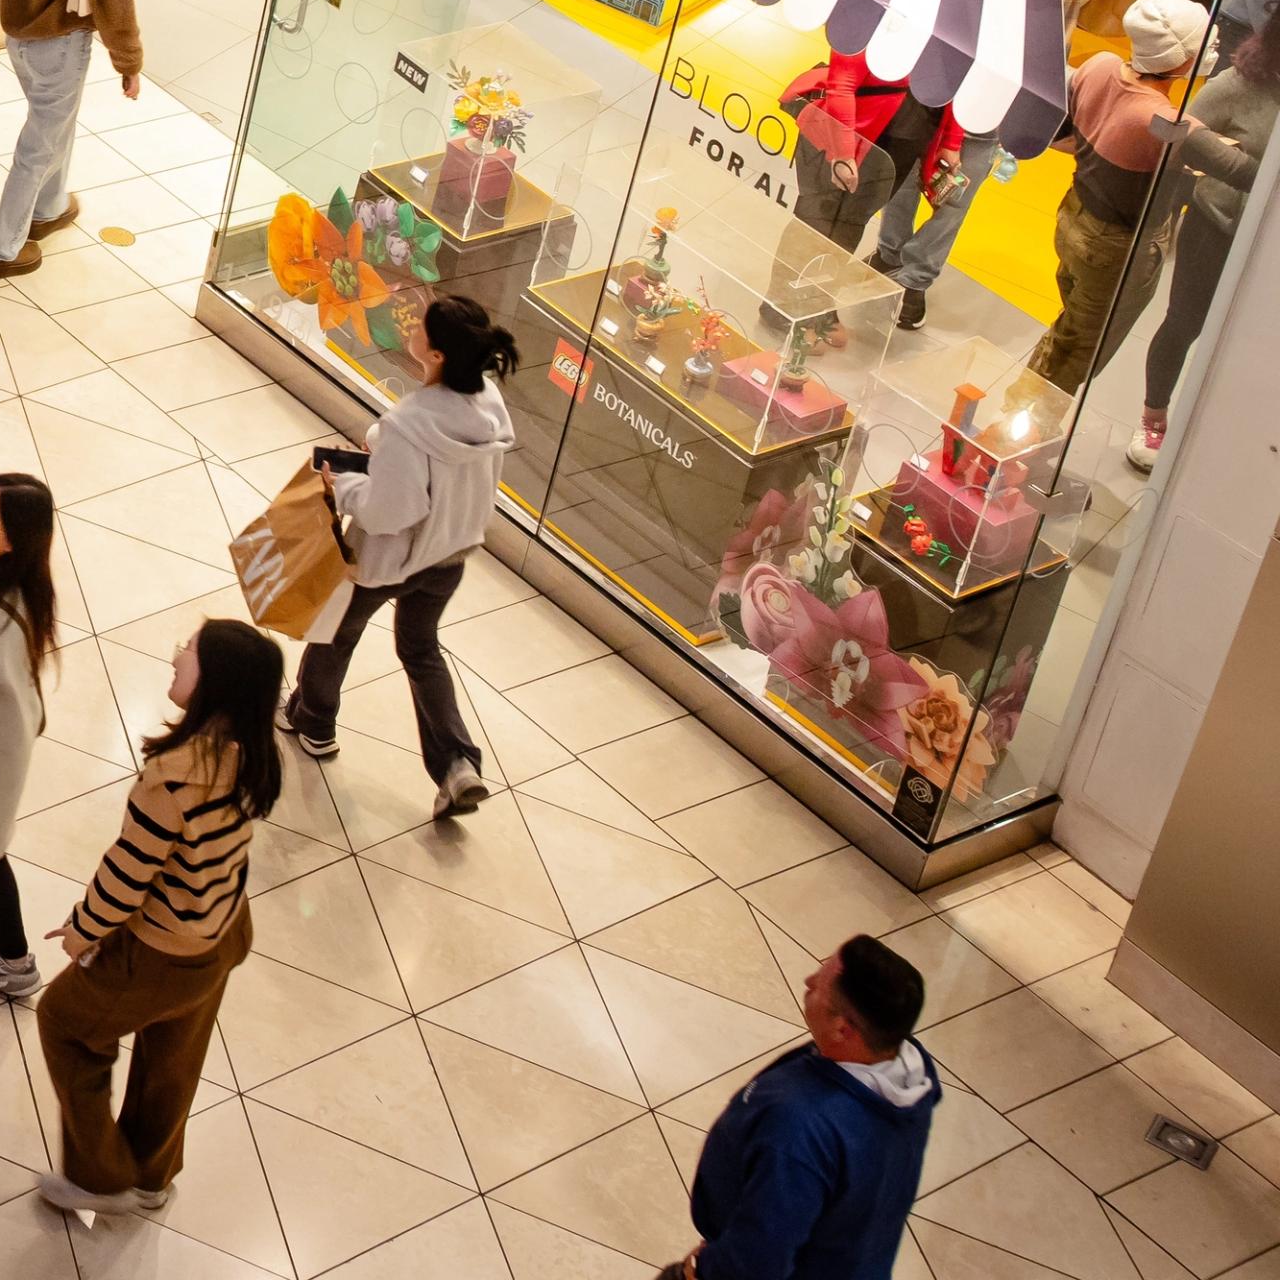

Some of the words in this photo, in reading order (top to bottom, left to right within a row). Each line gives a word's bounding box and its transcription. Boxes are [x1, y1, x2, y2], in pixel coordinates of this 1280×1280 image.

[397, 59, 426, 86] NEW
[669, 56, 800, 169] BLOO
[688, 126, 744, 177] FOR
[754, 172, 789, 209] AL
[593, 382, 695, 470] BOTANICALS
